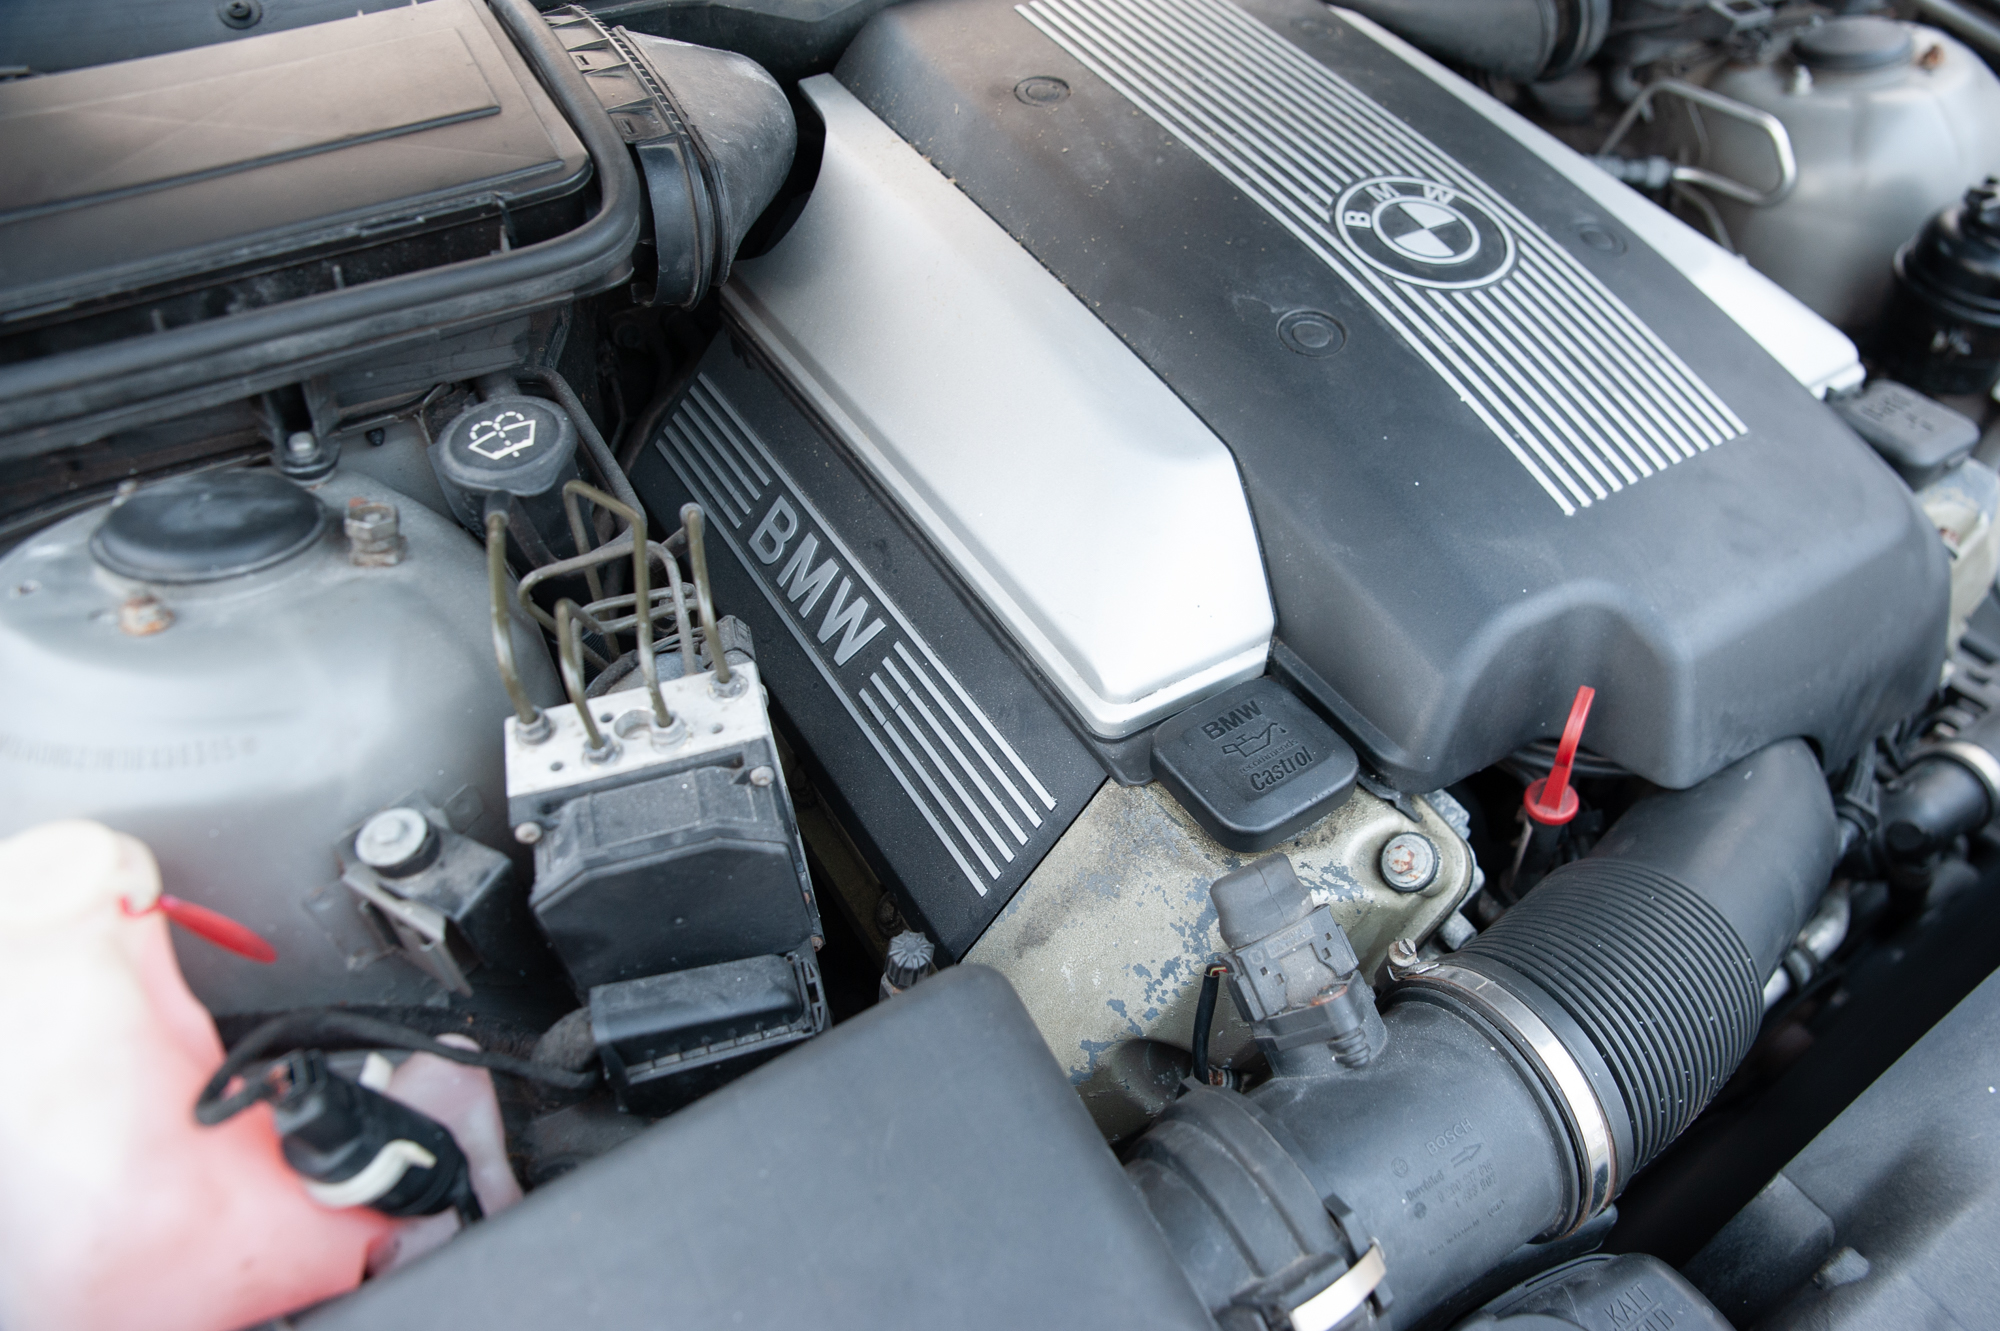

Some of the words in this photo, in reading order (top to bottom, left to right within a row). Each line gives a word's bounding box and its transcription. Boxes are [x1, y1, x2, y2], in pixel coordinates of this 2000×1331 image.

[1344, 182, 1456, 229] BMW
[748, 495, 887, 667] BMW
[1201, 700, 1263, 741] BMW
[1239, 737, 1299, 775] recommends
[1250, 745, 1313, 792] Castrol
[1424, 1117, 1474, 1156] BOSCH
[1603, 1281, 1653, 1329] KALT
